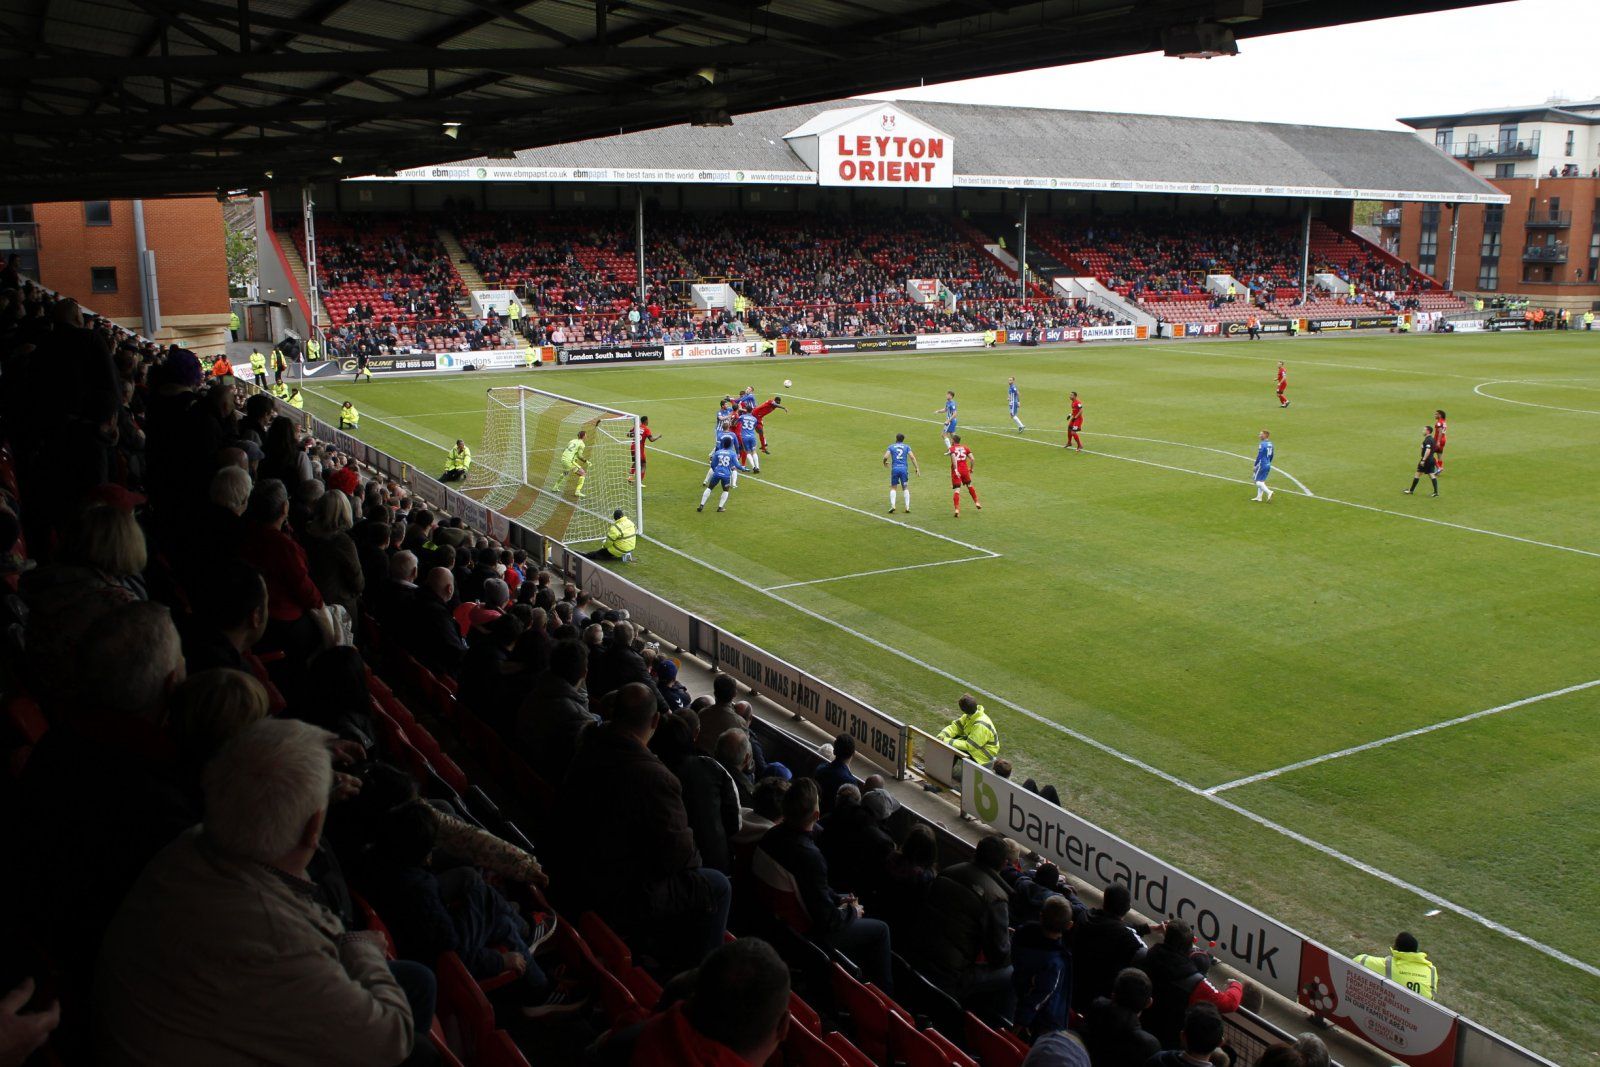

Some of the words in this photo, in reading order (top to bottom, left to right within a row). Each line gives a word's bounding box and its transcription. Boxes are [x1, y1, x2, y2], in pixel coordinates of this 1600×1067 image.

[838, 135, 943, 158] LEYTON
[405, 170, 426, 178] world
[432, 170, 470, 180] ebmpapst
[493, 170, 568, 181] www.ebmpapst.co.uk
[573, 170, 608, 180] ebmpapst
[613, 171, 625, 179] The
[627, 171, 641, 179] best
[642, 171, 657, 179] fans
[658, 171, 664, 179] in
[665, 172, 675, 180] the
[677, 172, 695, 180] world
[698, 171, 731, 181] ebmpapst
[751, 173, 812, 182] www.ebmpapst.co.uk
[839, 160, 936, 182] ORIENT
[1188, 325, 1202, 336] sky
[1203, 323, 1218, 333] BET
[1320, 320, 1339, 329] money
[1339, 319, 1353, 328] shop
[1009, 332, 1024, 343] sky
[1046, 330, 1061, 341] sky
[1063, 330, 1082, 340] BET
[1082, 328, 1114, 338] RAINHAM
[1115, 326, 1134, 336] STEEL
[569, 353, 594, 361] London
[595, 351, 614, 360] South
[615, 350, 633, 358] Bank
[634, 349, 663, 358] University
[688, 345, 741, 358] allendavies
[455, 357, 492, 369] Theydons
[742, 419, 754, 431] 33
[896, 448, 904, 460] 2
[955, 450, 967, 461] 25
[718, 455, 730, 467] 38
[719, 642, 741, 671] BOOK
[741, 654, 762, 682] YOUR
[764, 666, 789, 698] XMAS
[790, 680, 821, 714] PARTY
[824, 698, 847, 732] 0871
[850, 714, 867, 744] 310
[870, 725, 896, 762] 1885
[1008, 792, 1279, 979] bartercard.co.uk
[1365, 1006, 1388, 1022] FAMILY
[1388, 1019, 1405, 1031] AREA
